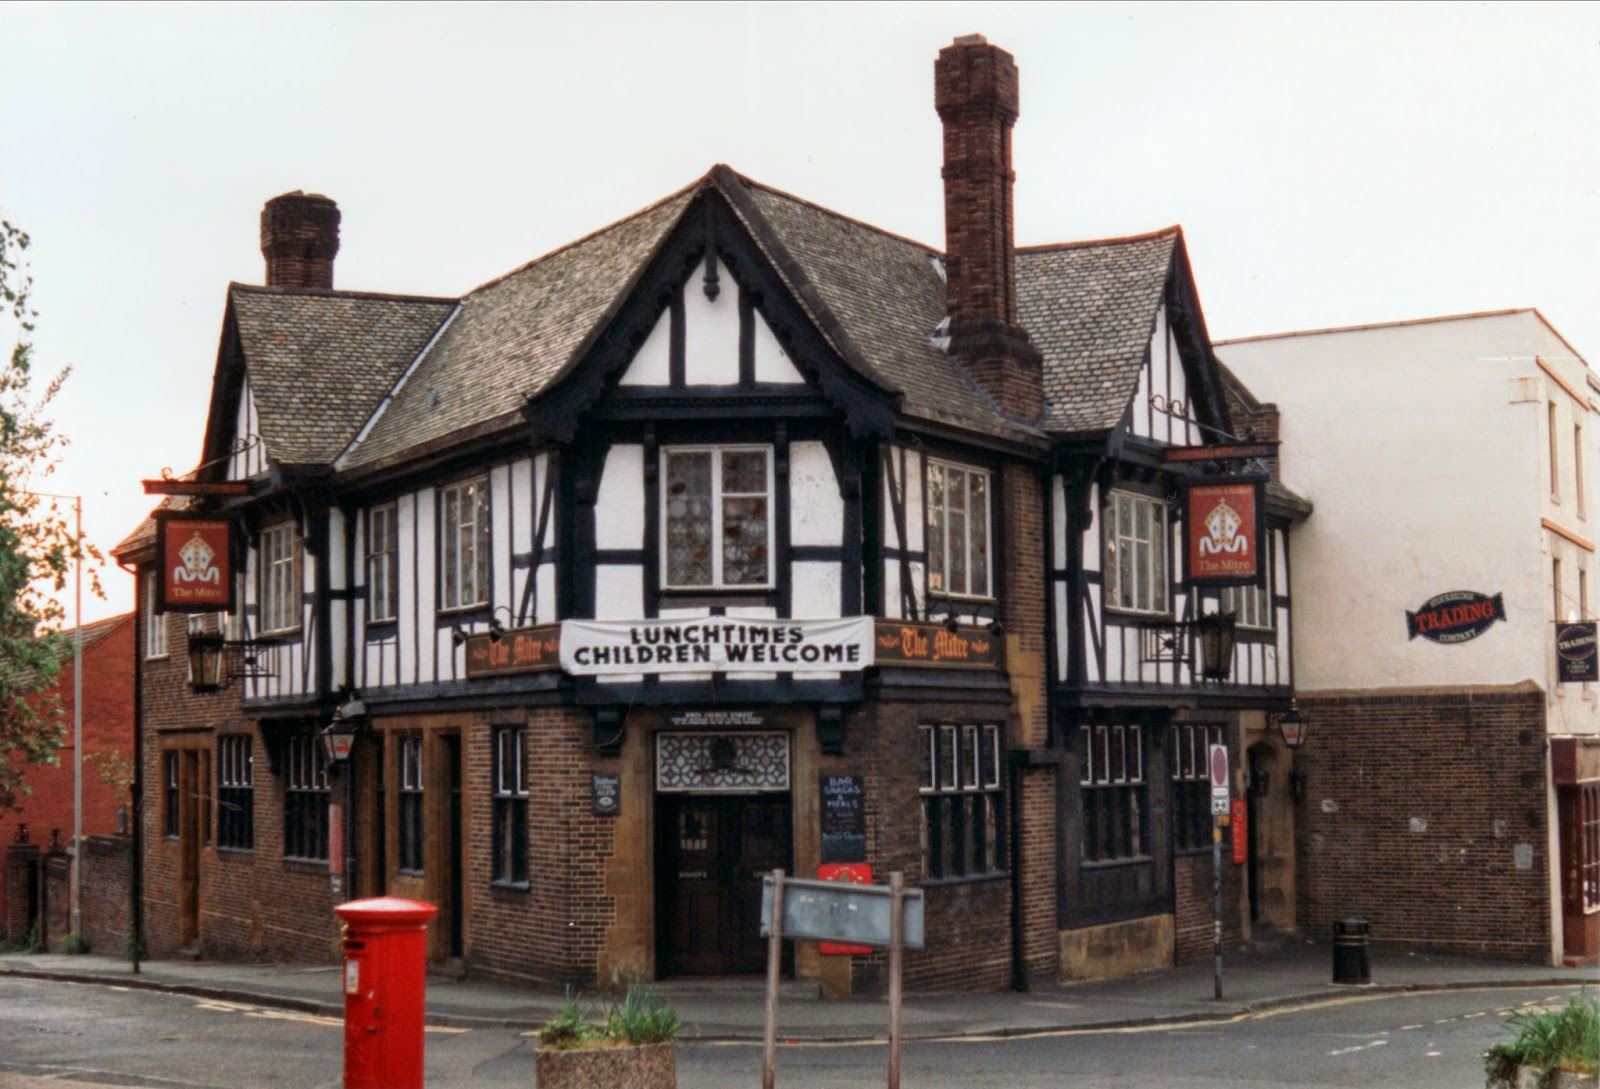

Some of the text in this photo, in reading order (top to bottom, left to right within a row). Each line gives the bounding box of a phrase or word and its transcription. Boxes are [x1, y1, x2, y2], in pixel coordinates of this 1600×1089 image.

[1200, 560, 1249, 571] The Mitre
[173, 587, 193, 597] The
[1415, 601, 1495, 632] TRADING
[630, 624, 804, 645] LUNCHTIMES
[1439, 628, 1476, 642] COMPANY
[901, 627, 968, 661] The Mitre
[1559, 635, 1597, 650] TRADING
[574, 643, 860, 665] CHILDREN WELCOME
[829, 776, 853, 786] BAR
[824, 785, 861, 794] SNACKS
[827, 800, 858, 809] MEALS
